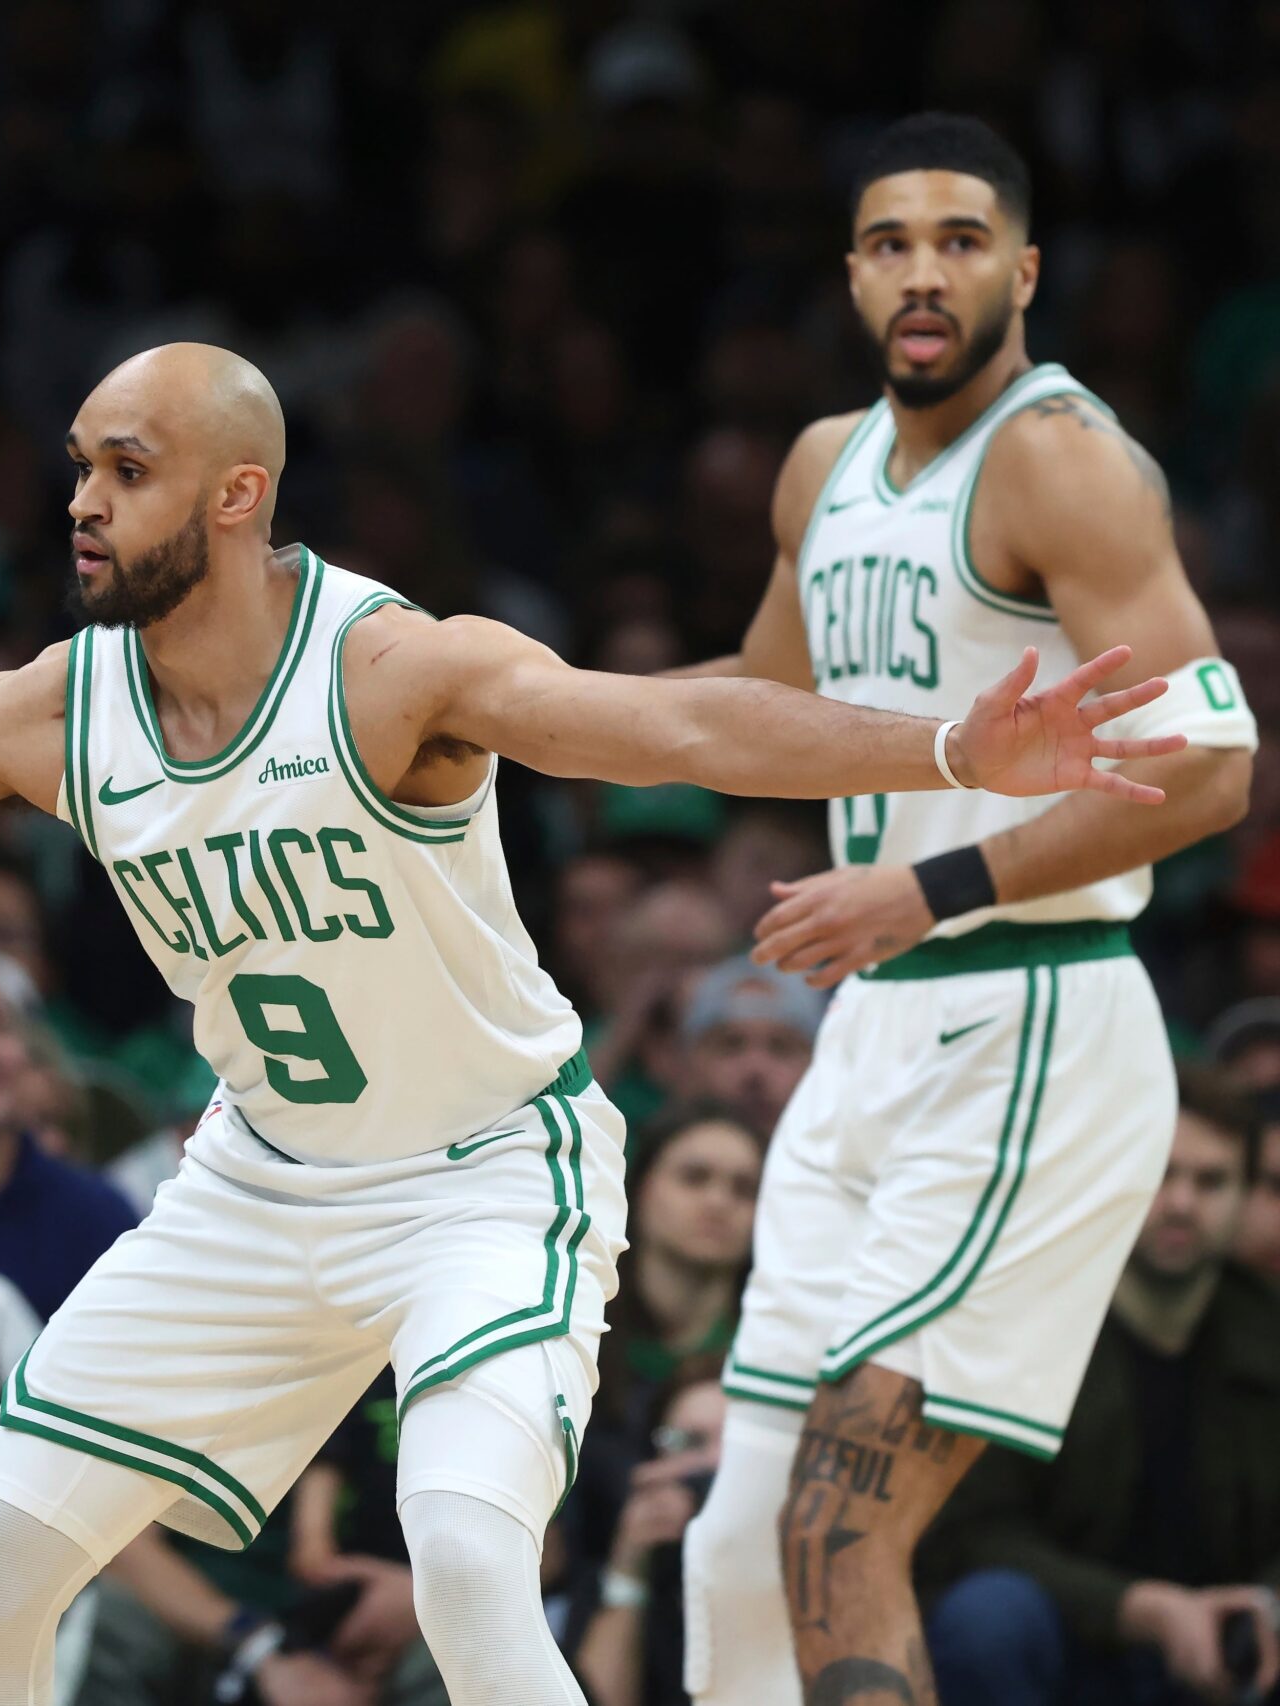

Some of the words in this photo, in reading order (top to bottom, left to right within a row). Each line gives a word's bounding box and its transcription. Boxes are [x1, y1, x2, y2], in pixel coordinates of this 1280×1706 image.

[805, 553, 939, 690] CELTICS
[258, 754, 330, 784] Amica
[112, 827, 395, 962] CELTICS
[227, 972, 368, 1104] 9
